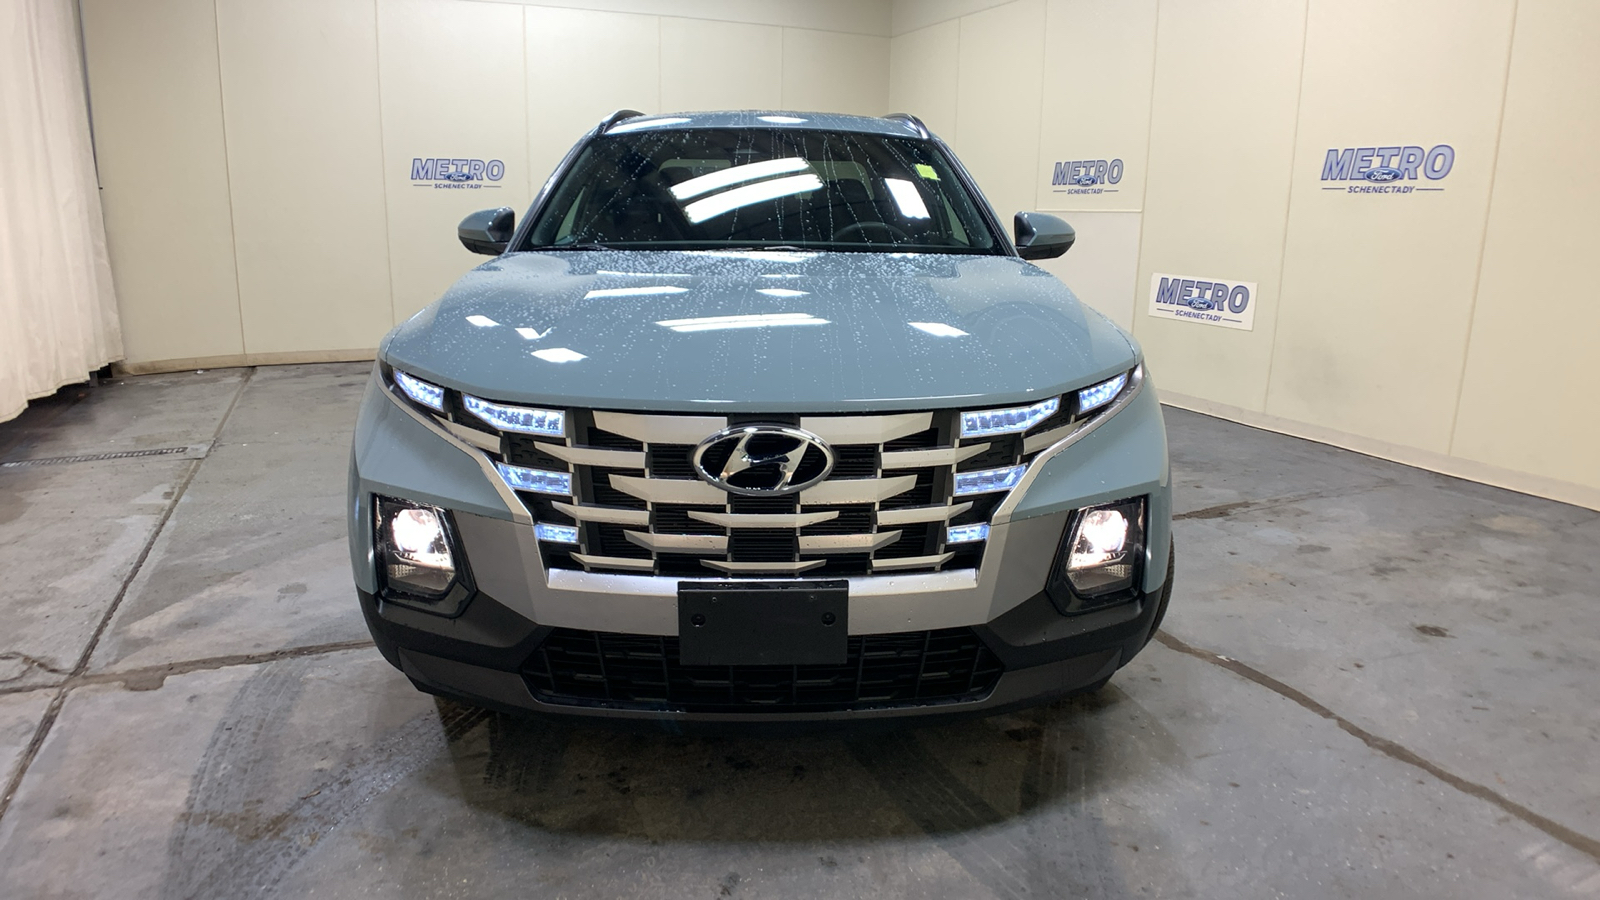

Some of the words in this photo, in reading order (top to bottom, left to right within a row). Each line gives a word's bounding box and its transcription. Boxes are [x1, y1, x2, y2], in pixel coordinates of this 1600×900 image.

[411, 158, 505, 181] METRO
[1052, 158, 1124, 186] METRO
[1320, 144, 1455, 181] METRO
[1347, 185, 1416, 194] SCHENECTADY
[1155, 277, 1250, 314] METRO
[1174, 309, 1223, 322] SCHENECTADY
